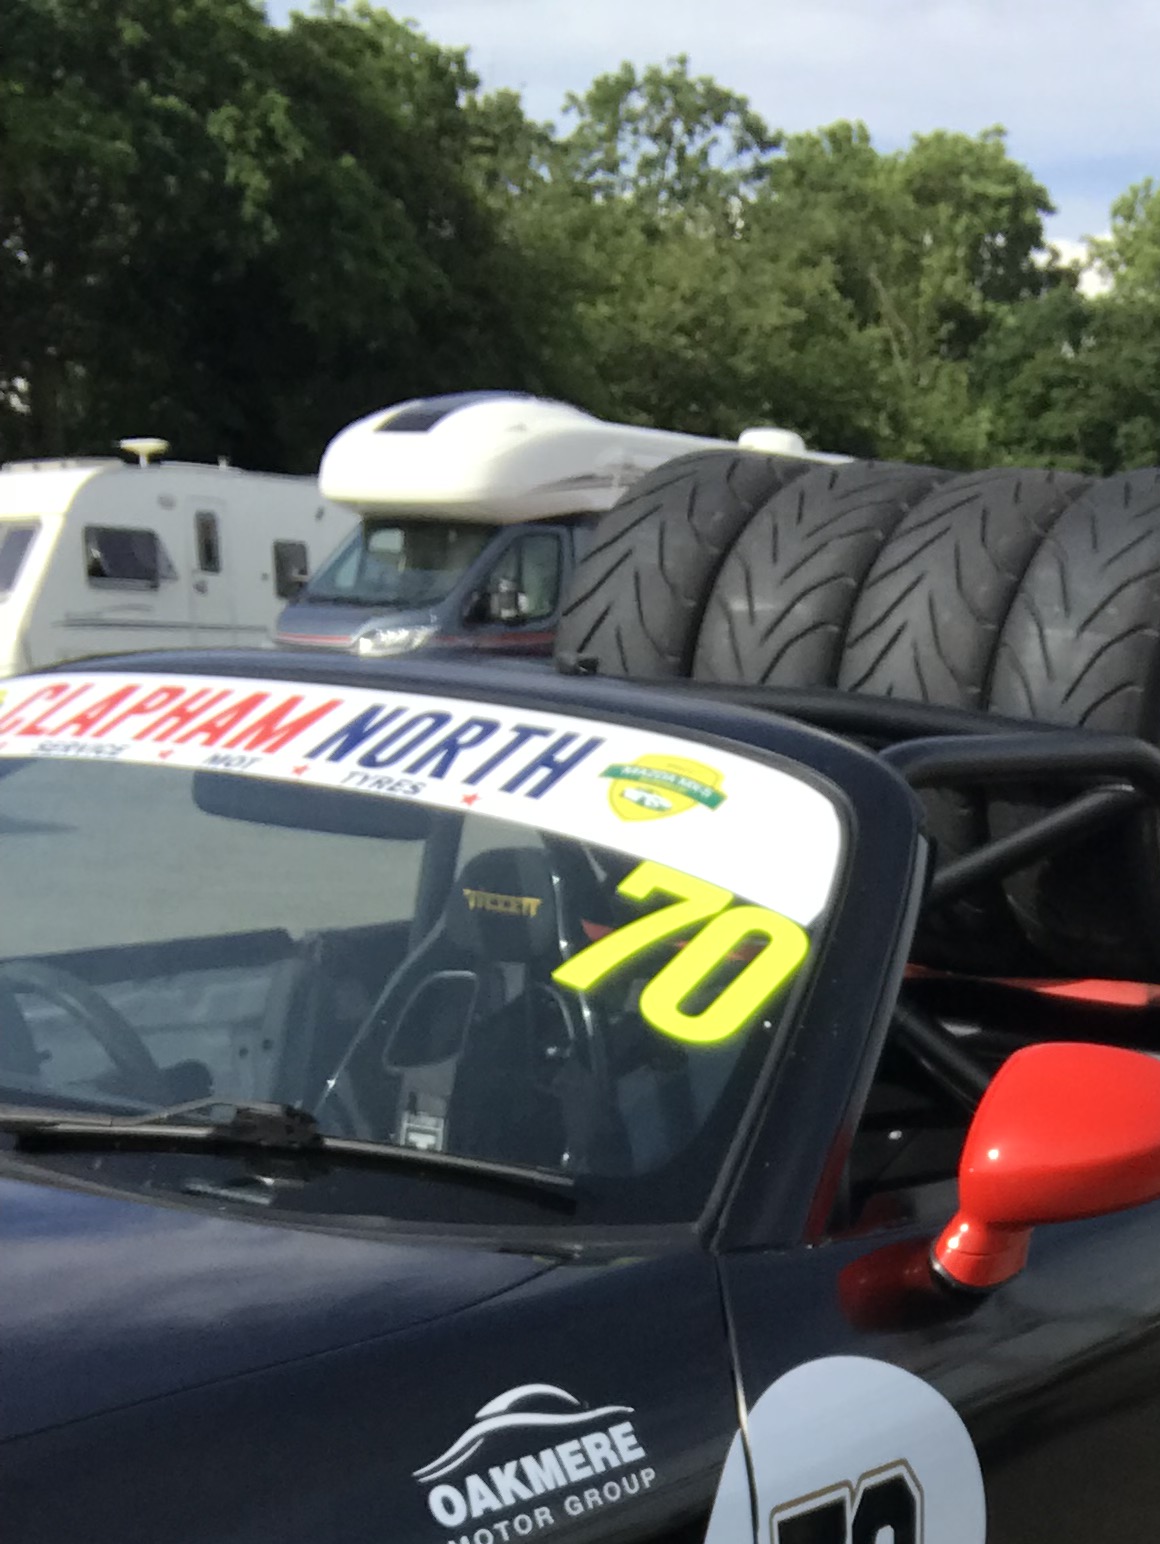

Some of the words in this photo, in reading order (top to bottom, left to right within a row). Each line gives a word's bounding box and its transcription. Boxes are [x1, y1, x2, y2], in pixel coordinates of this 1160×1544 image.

[0, 682, 343, 755] CLAPHAM
[303, 703, 606, 800] NORTH
[202, 752, 263, 770] MOT
[341, 771, 427, 795] TYRES
[551, 860, 810, 1042] 70
[428, 1421, 647, 1528] OAKMERE
[563, 1467, 657, 1517] GROUP
